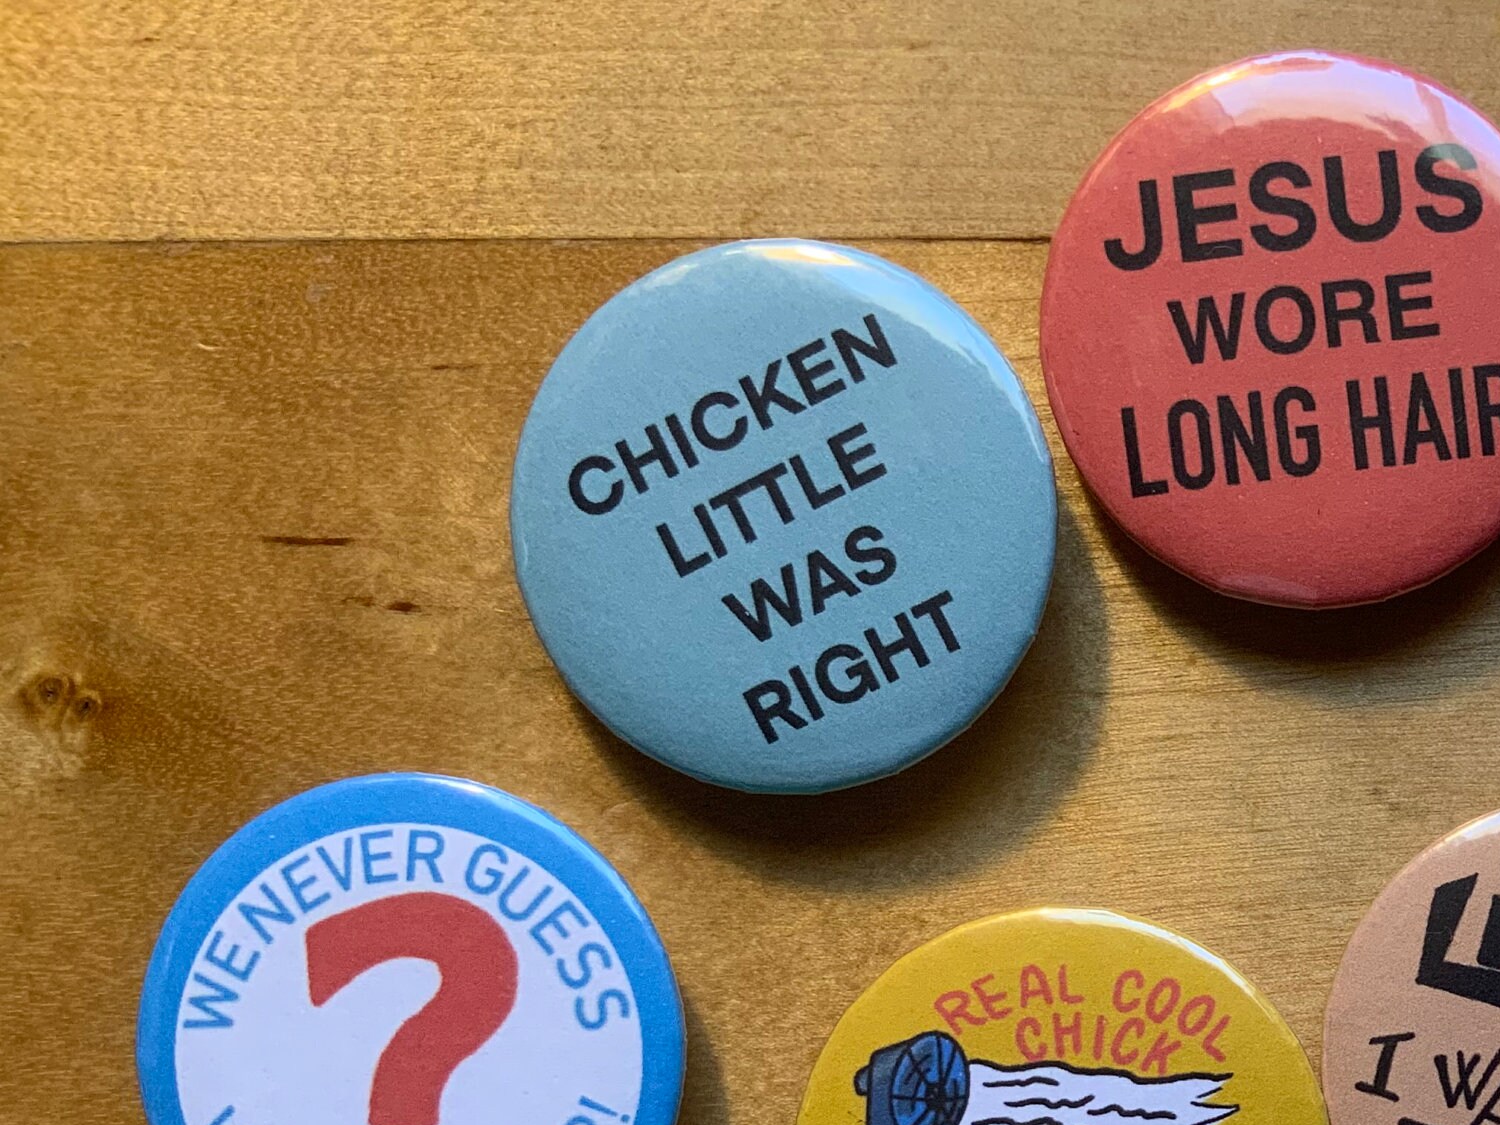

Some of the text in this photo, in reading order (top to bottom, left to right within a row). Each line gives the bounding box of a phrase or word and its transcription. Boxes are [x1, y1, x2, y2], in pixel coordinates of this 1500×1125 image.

[1103, 142, 1484, 272] JESUS
[1166, 270, 1441, 365] WORE
[567, 312, 898, 516] CHICKEN
[1120, 385, 1323, 499] LONG
[655, 422, 888, 579] LITTLE
[720, 524, 898, 643] WAS
[741, 589, 962, 745] RIGHT
[464, 843, 630, 1032] GUESS
[934, 962, 1235, 1064] REAL COOL
[1014, 1012, 1185, 1075] CHICK
[1354, 1031, 1416, 1103] I
